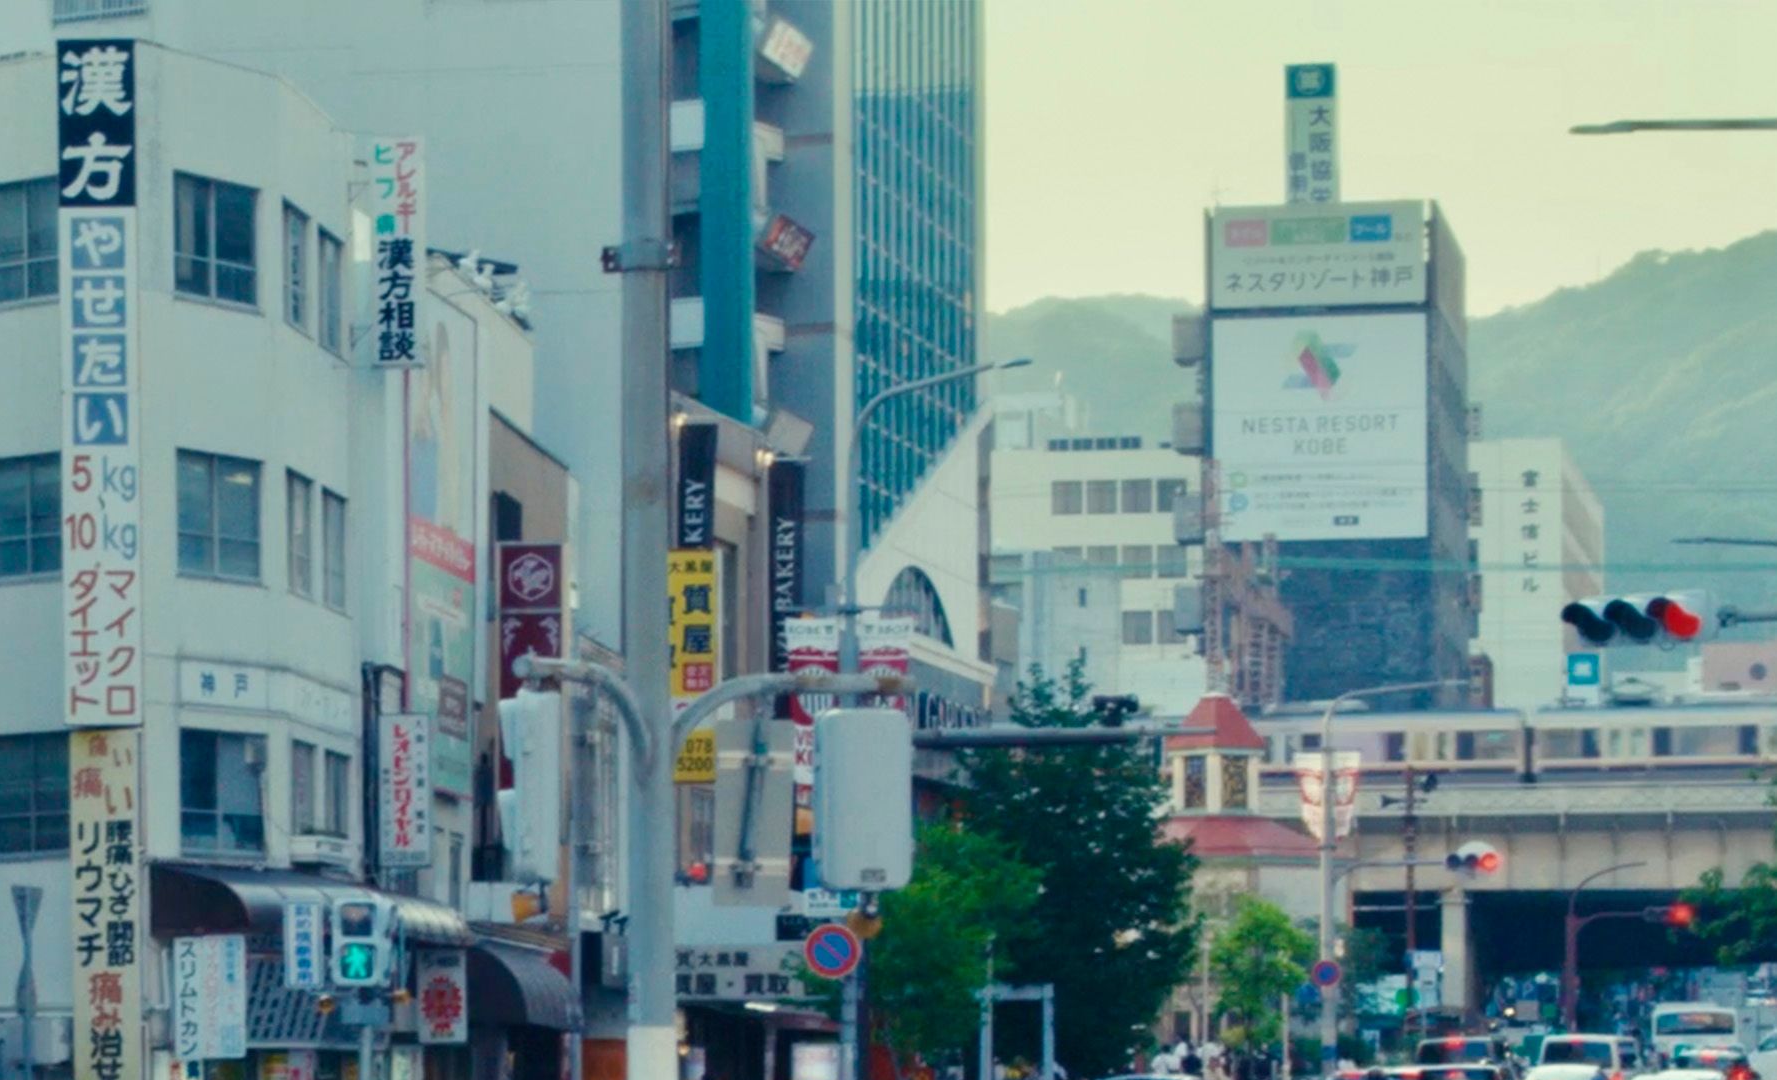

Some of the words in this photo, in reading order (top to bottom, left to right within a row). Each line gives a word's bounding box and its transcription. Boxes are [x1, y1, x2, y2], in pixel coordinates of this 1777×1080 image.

[61, 46, 132, 200] 漢方
[396, 142, 417, 234] アレルギー
[378, 238, 415, 362] 漢方相談
[1226, 266, 1413, 292] ネスタリゾート神戸
[73, 221, 123, 443] やせたい
[1242, 416, 1310, 435] NESTA
[1316, 413, 1399, 433] RESORT
[1293, 437, 1348, 455] KOBE
[775, 517, 795, 611] BAKERY
[70, 563, 100, 715] ダイエット
[105, 570, 135, 715] マイクロ
[683, 584, 712, 654] 質屋
[74, 767, 132, 815] 痛い
[76, 822, 103, 966] リウマチ
